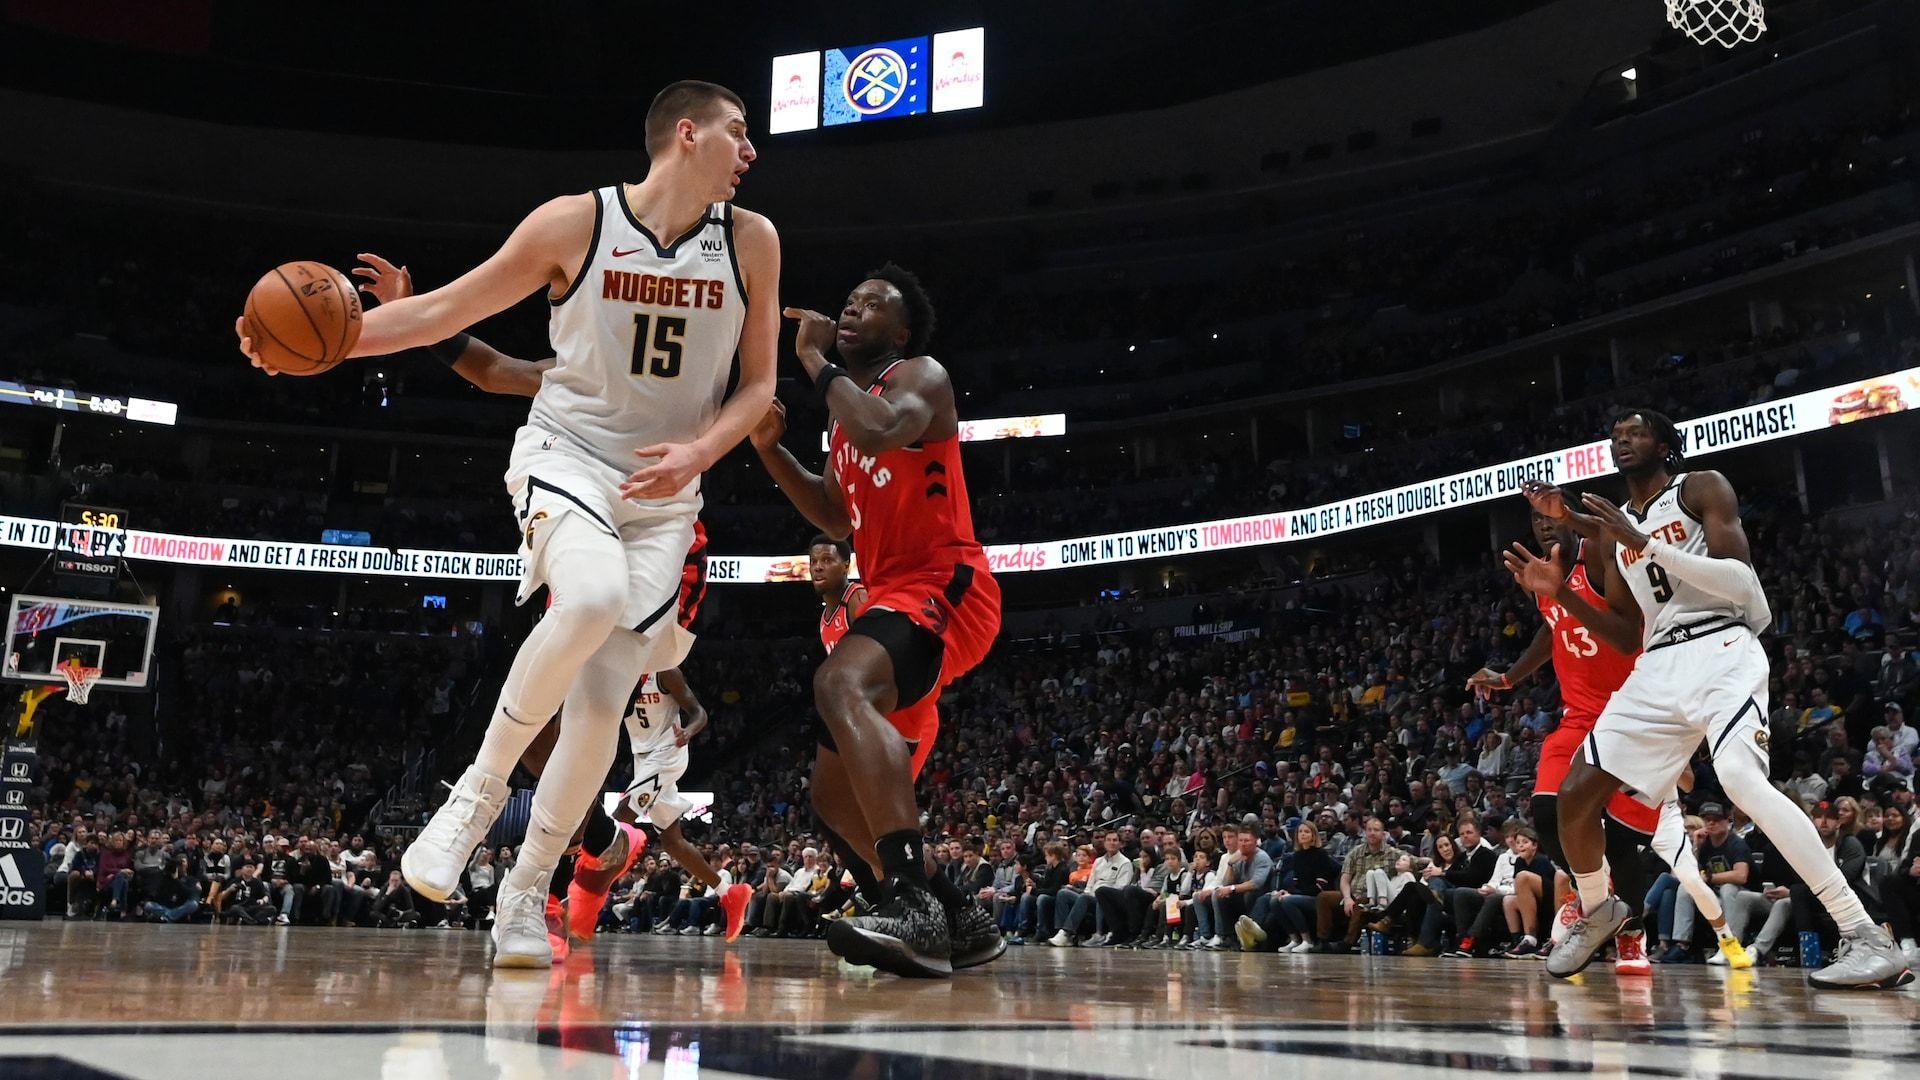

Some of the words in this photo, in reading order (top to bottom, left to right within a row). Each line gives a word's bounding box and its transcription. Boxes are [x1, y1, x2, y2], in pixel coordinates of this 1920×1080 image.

[700, 240, 722, 250] WU
[602, 270, 725, 309] NUGGETS
[630, 313, 687, 379] 15
[984, 546, 1046, 571] endy's
[1061, 541, 1097, 565] COME
[1101, 539, 1114, 560] IN
[1118, 536, 1133, 558] TO
[1137, 528, 1198, 556] WENDY'S
[1202, 517, 1286, 548] TOMORROW
[1290, 513, 1317, 537] AND
[1320, 506, 1341, 531] GET
[1345, 505, 1353, 526] A
[1356, 497, 1394, 524] FRESH
[1397, 483, 1446, 515] DOUBLE
[1450, 472, 1493, 503] STACK
[1566, 445, 1606, 479] FREE
[1695, 403, 1796, 450] PURCHASE!
[82, 510, 119, 529] 5:30
[8, 522, 26, 542] IN
[31, 524, 51, 544] TO
[132, 535, 225, 562] TOMORROW
[228, 544, 260, 564] AND
[264, 546, 292, 565] GET
[296, 548, 306, 566] A
[310, 549, 358, 568] FRESH
[362, 551, 419, 572] DOUBLE
[423, 554, 471, 575] STACK
[475, 557, 525, 576] BURGE
[76, 562, 116, 573] TISSOT
[1645, 561, 1674, 604] 9
[1561, 626, 1599, 659] 43
[0, 885, 36, 906] das
